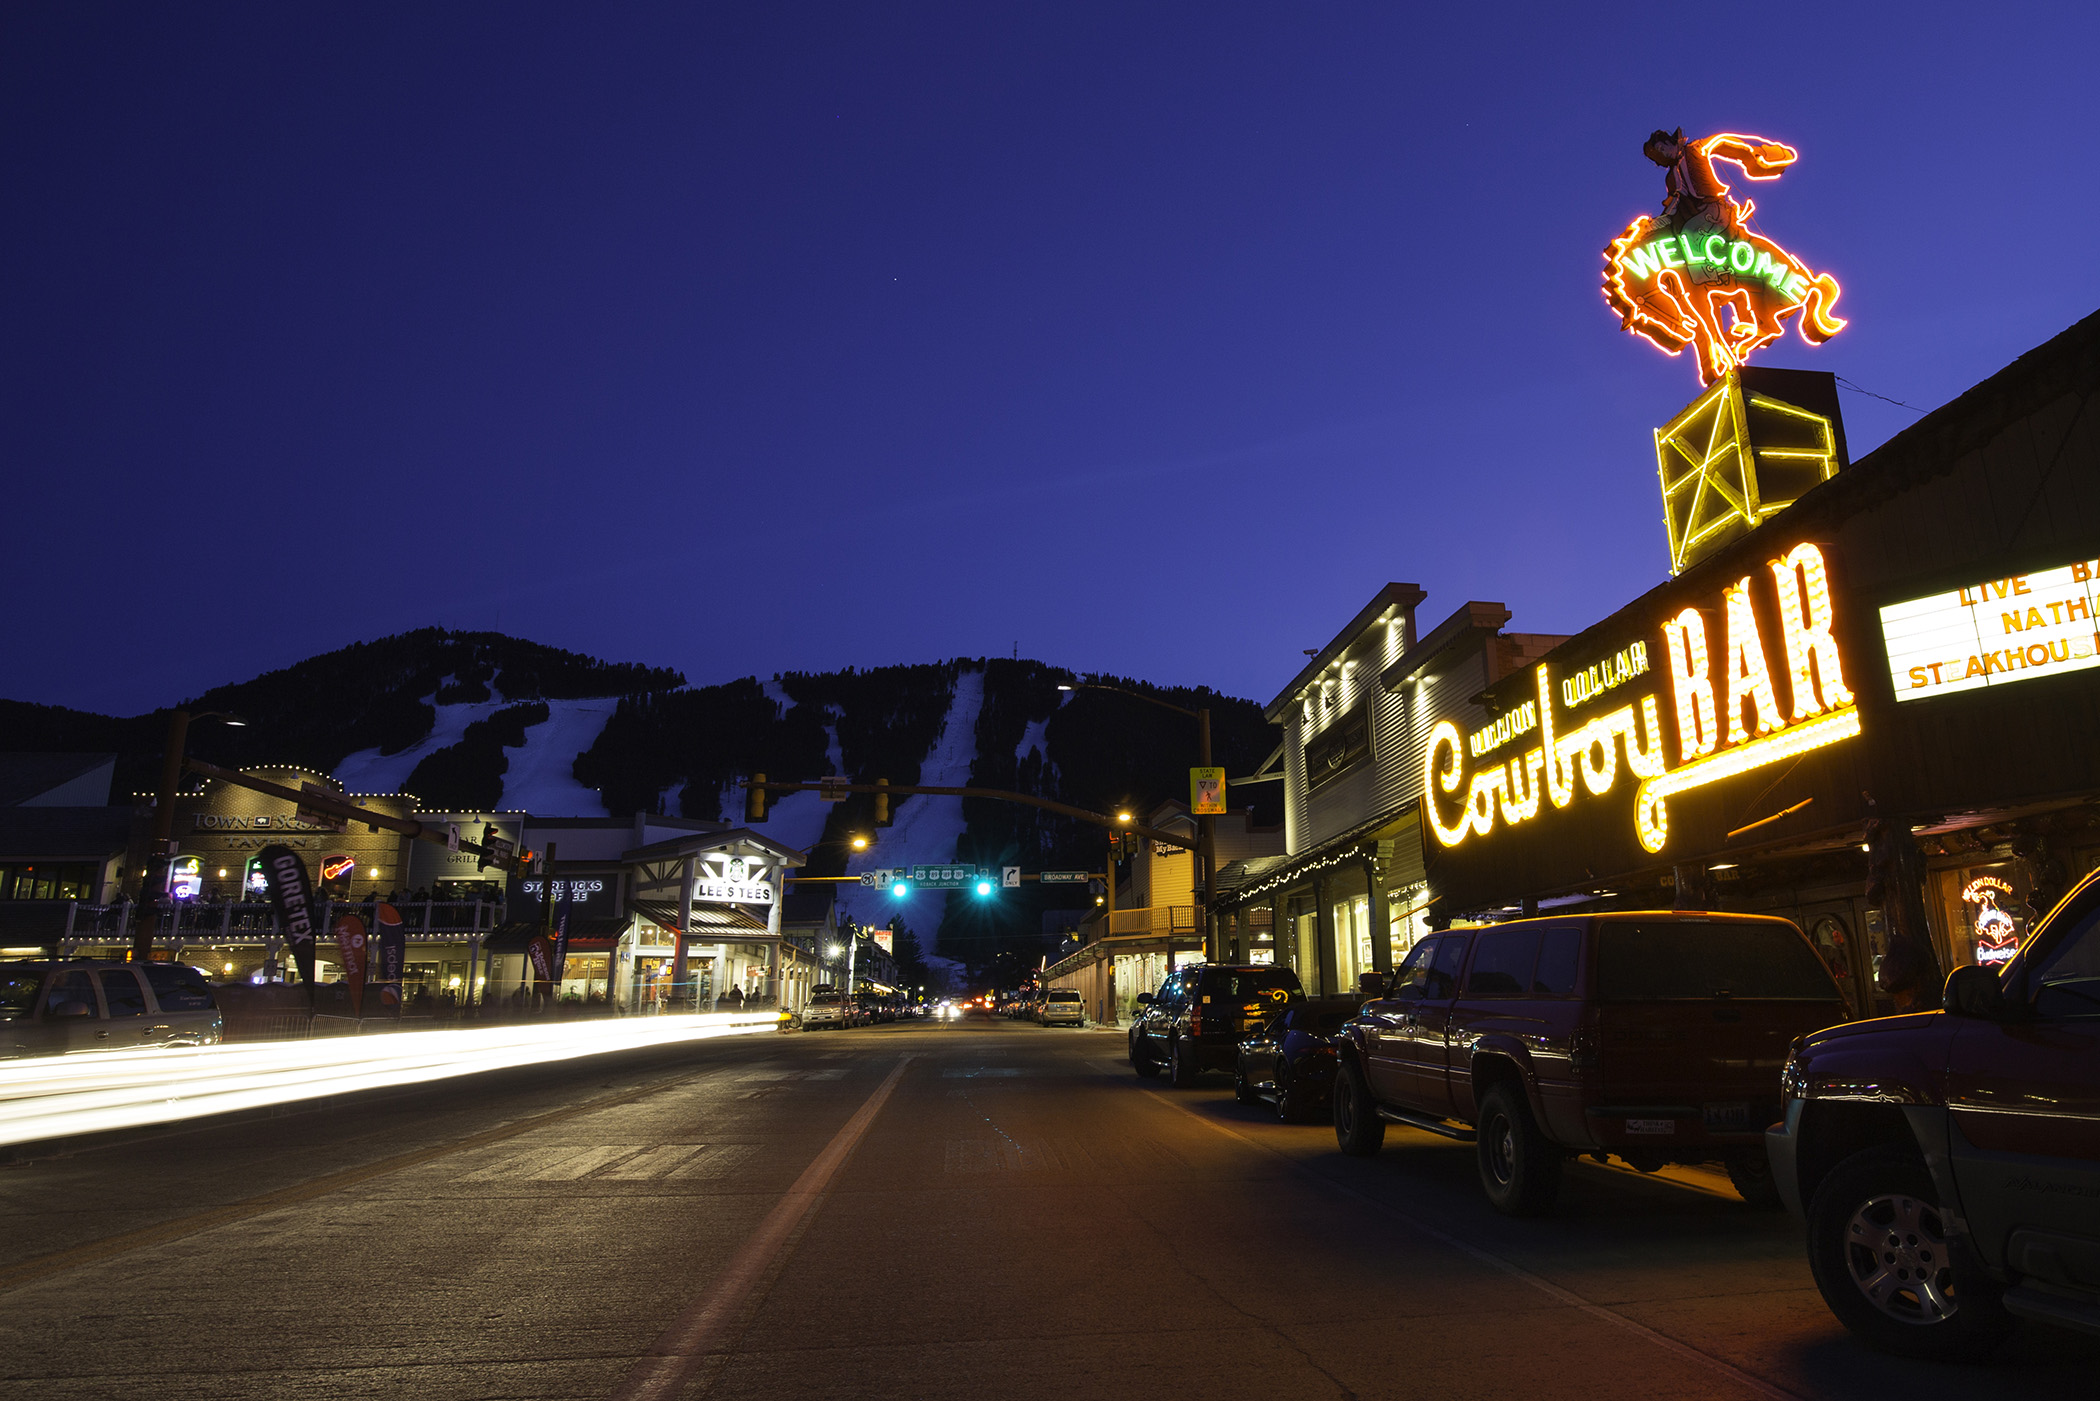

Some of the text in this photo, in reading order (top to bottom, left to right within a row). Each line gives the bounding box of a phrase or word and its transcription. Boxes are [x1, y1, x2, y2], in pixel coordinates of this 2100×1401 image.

[1620, 234, 1809, 304] WELCOME
[1959, 559, 2100, 607] LIVE B
[2001, 593, 2100, 634] NATH
[1424, 542, 1855, 853] Cowboy BAR
[1469, 640, 1650, 757] MILLION DOLLAR
[192, 812, 249, 829] TOWN
[699, 885, 770, 900] LEE'S TEES
[916, 871, 925, 879] 26
[930, 871, 938, 879] 89
[1983, 876, 2013, 895] DOLLAR
